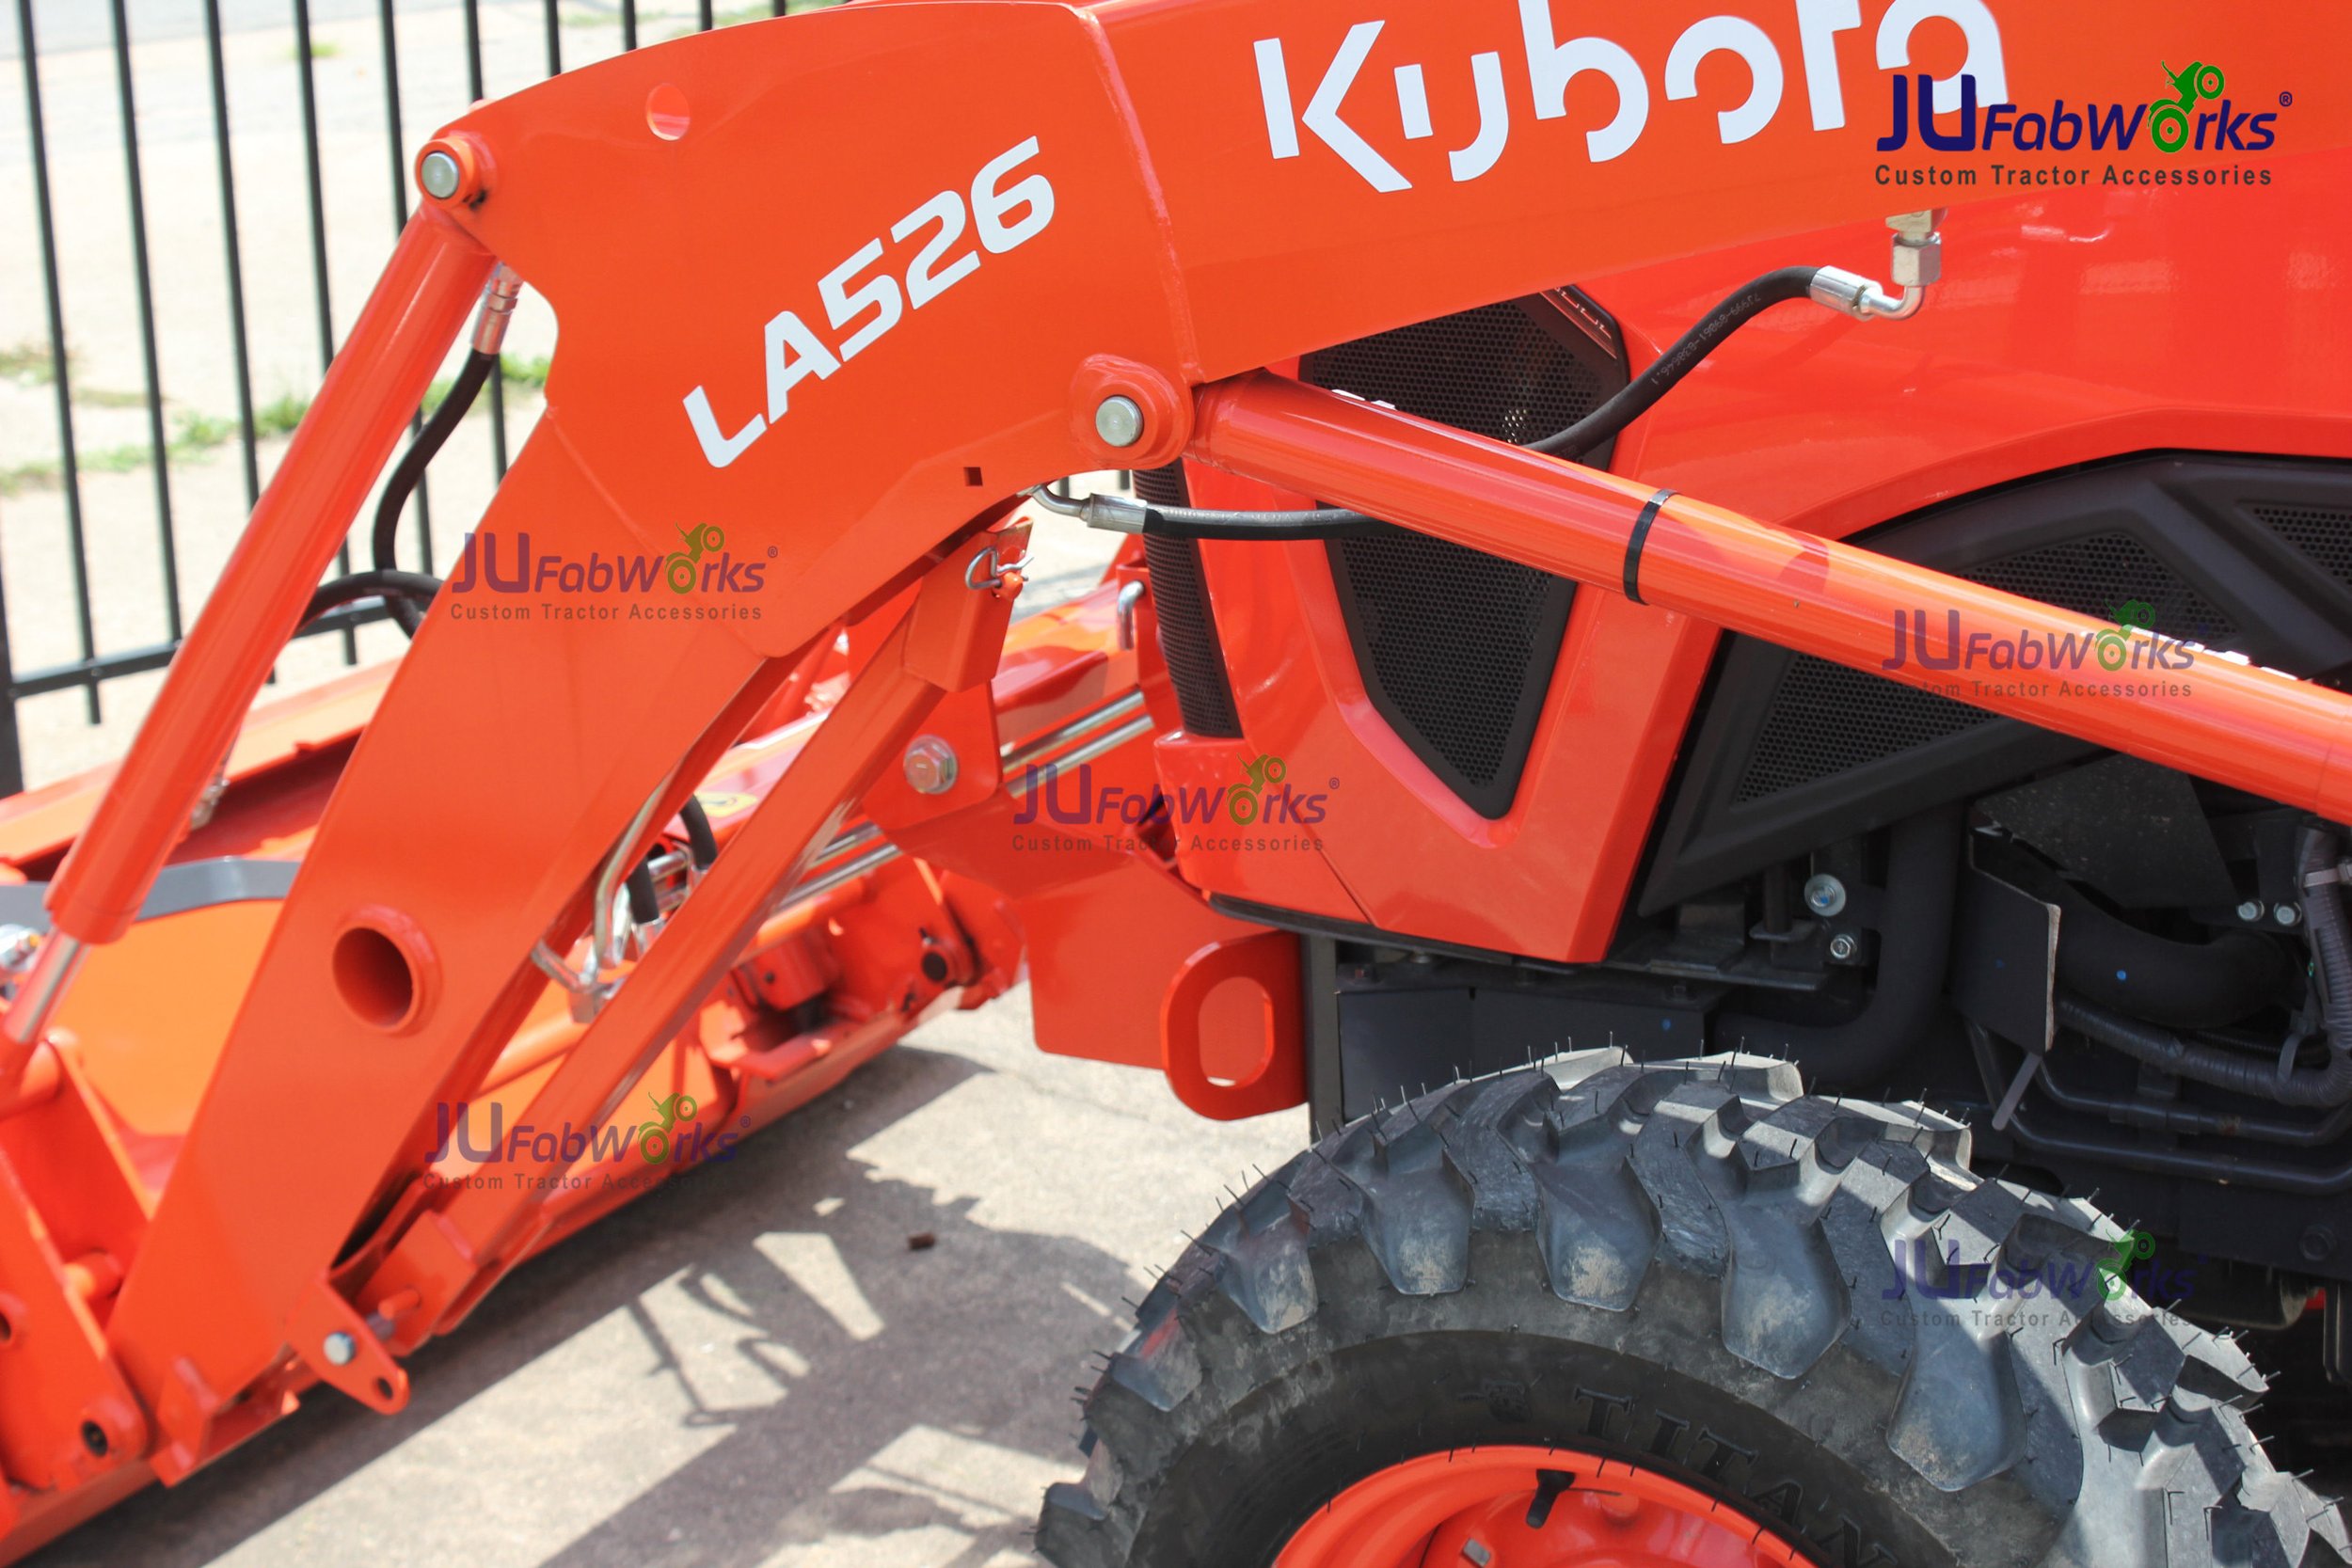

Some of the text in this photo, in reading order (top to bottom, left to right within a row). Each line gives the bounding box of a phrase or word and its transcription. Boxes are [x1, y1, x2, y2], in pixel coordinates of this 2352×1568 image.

[1253, 0, 2010, 192] Kubota
[682, 135, 1056, 468] LA526
[1573, 1386, 1899, 1568] TITAN
